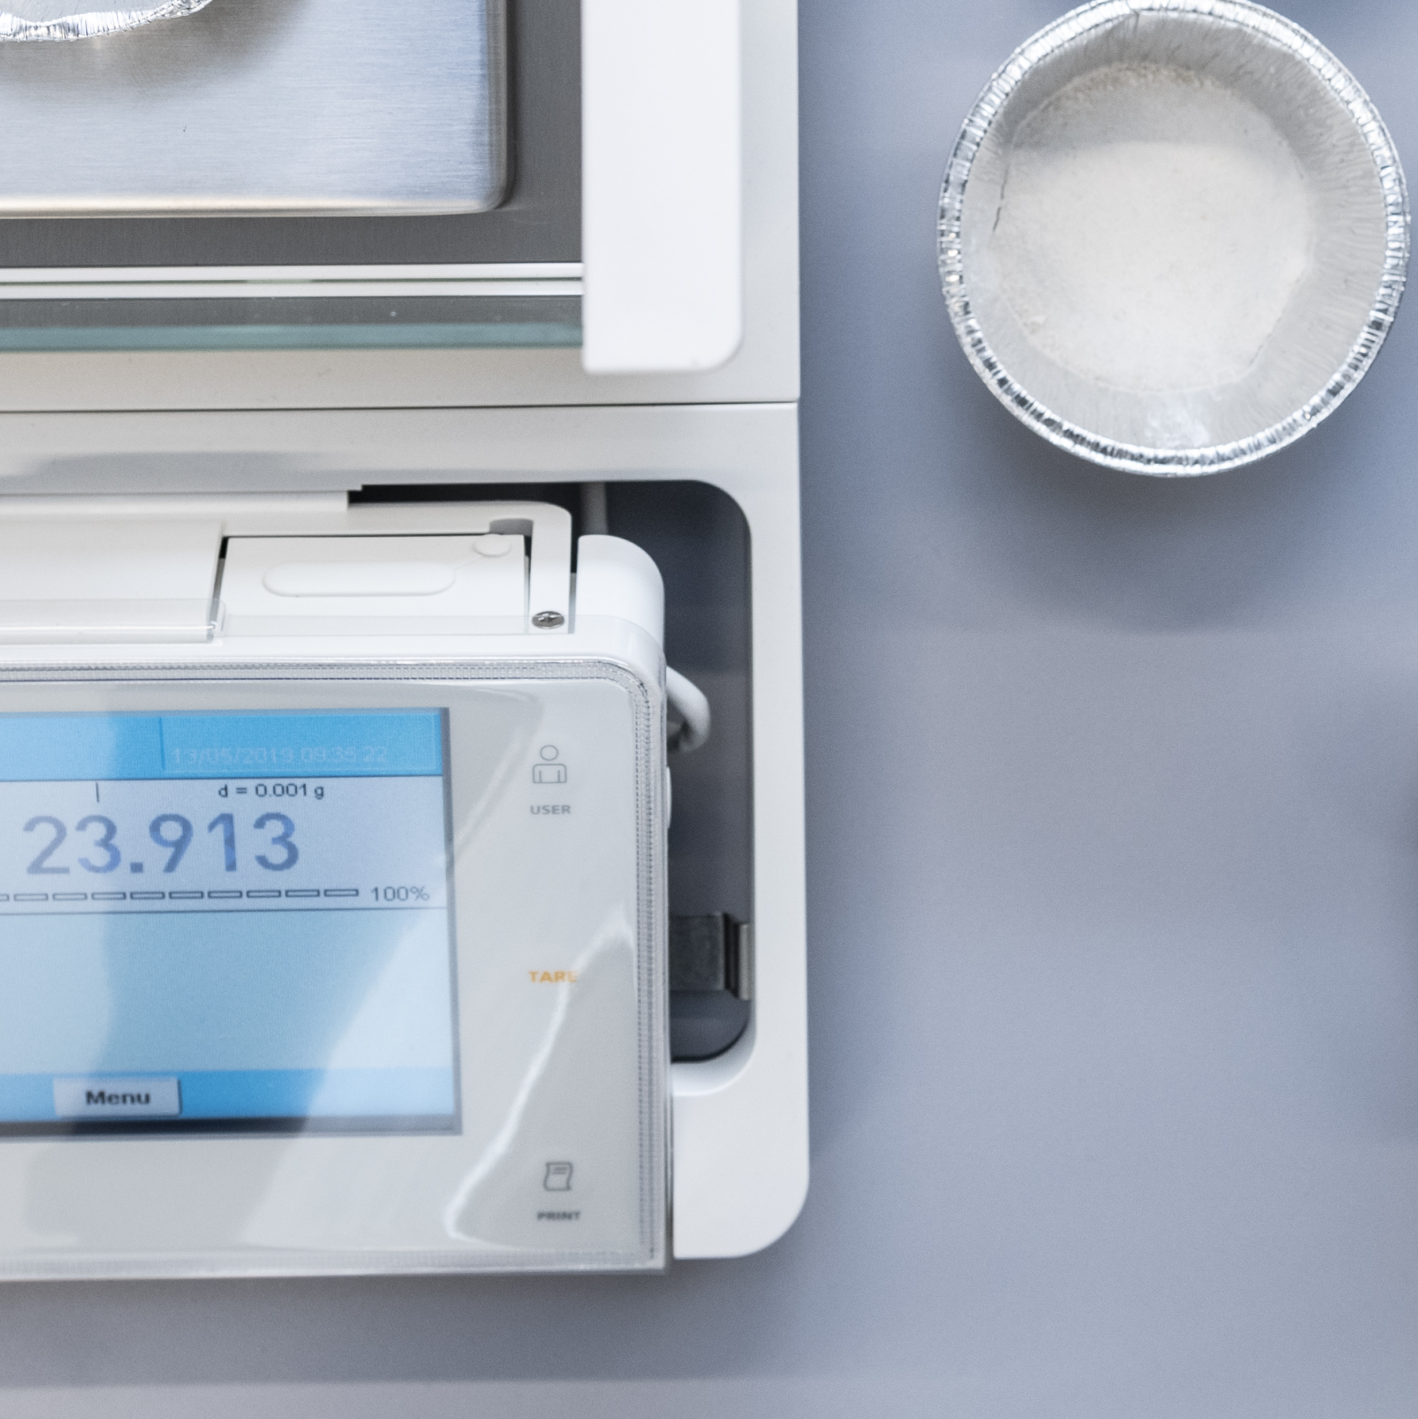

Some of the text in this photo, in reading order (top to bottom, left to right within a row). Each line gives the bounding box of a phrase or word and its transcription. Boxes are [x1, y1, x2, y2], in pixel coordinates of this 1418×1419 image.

[218, 785, 229, 798] d
[255, 784, 307, 797] 0.001
[313, 786, 325, 800] g
[530, 804, 572, 816] USER
[23, 813, 300, 874] 23.913
[370, 886, 431, 903] 100%
[528, 970, 578, 984] TARE
[85, 1088, 151, 1107] Menu
[537, 1211, 580, 1220] PRINT
